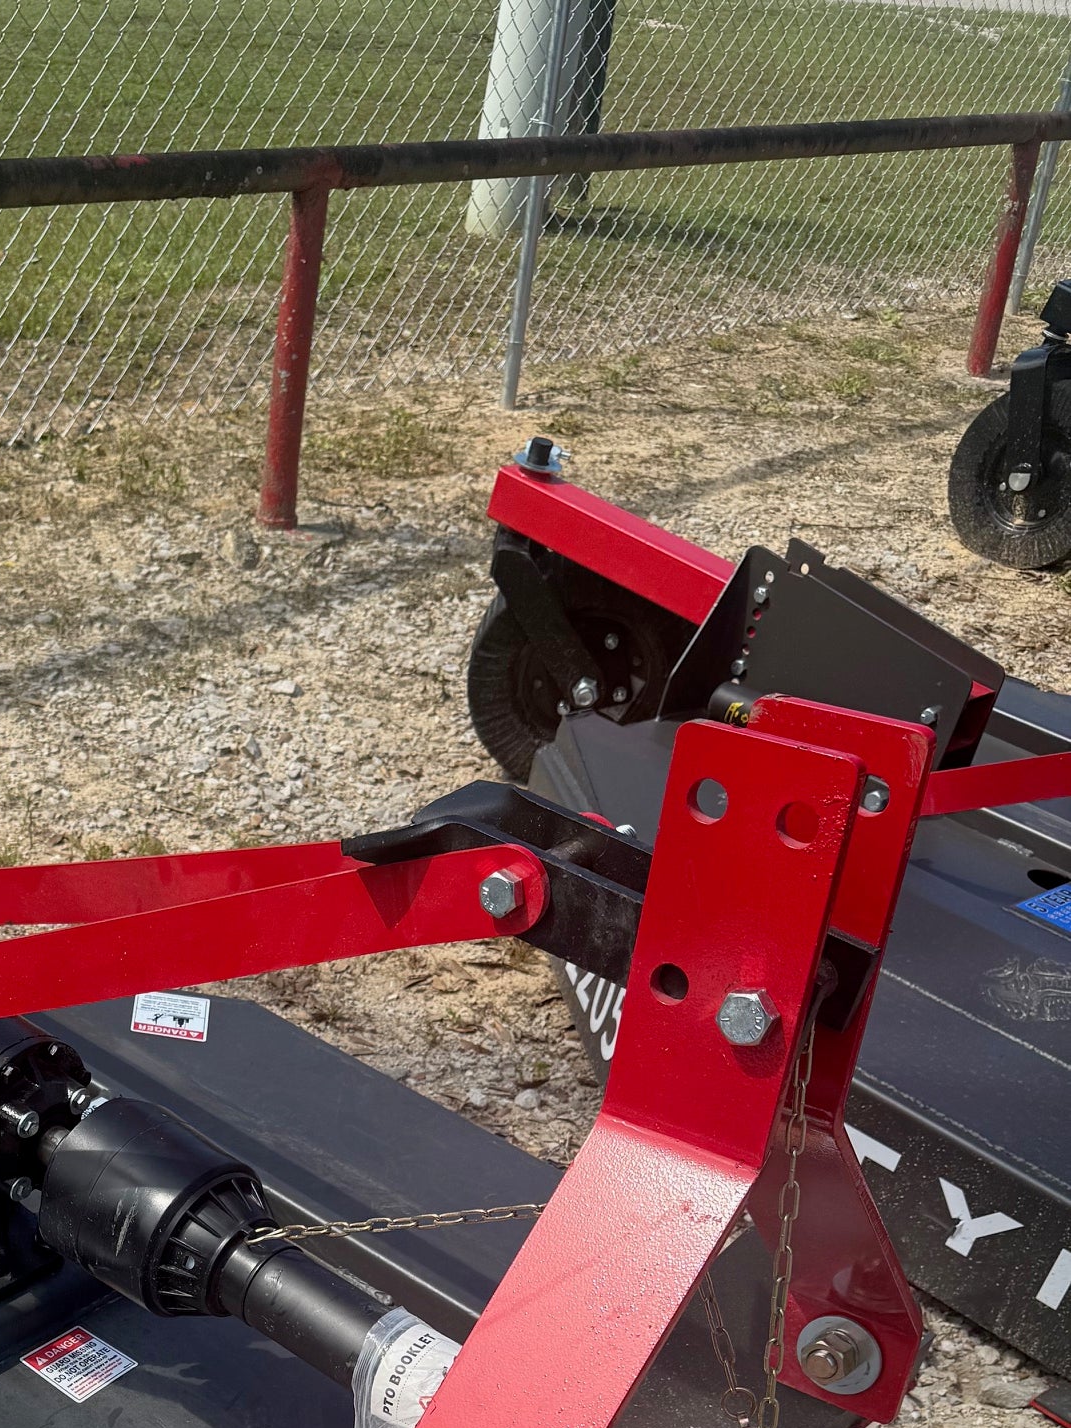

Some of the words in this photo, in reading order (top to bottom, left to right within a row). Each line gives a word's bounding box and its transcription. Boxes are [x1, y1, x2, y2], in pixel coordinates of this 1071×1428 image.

[1025, 902, 1049, 914] 5
[45, 1334, 84, 1358] DANGER
[46, 1357, 71, 1373] GUARD
[68, 1341, 97, 1359] MISSING
[54, 1374, 67, 1383] DO
[64, 1365, 81, 1376] NOT
[79, 1347, 111, 1367] OPERATE
[382, 1385, 396, 1416] PTO
[389, 1333, 437, 1386] BOOKLET
